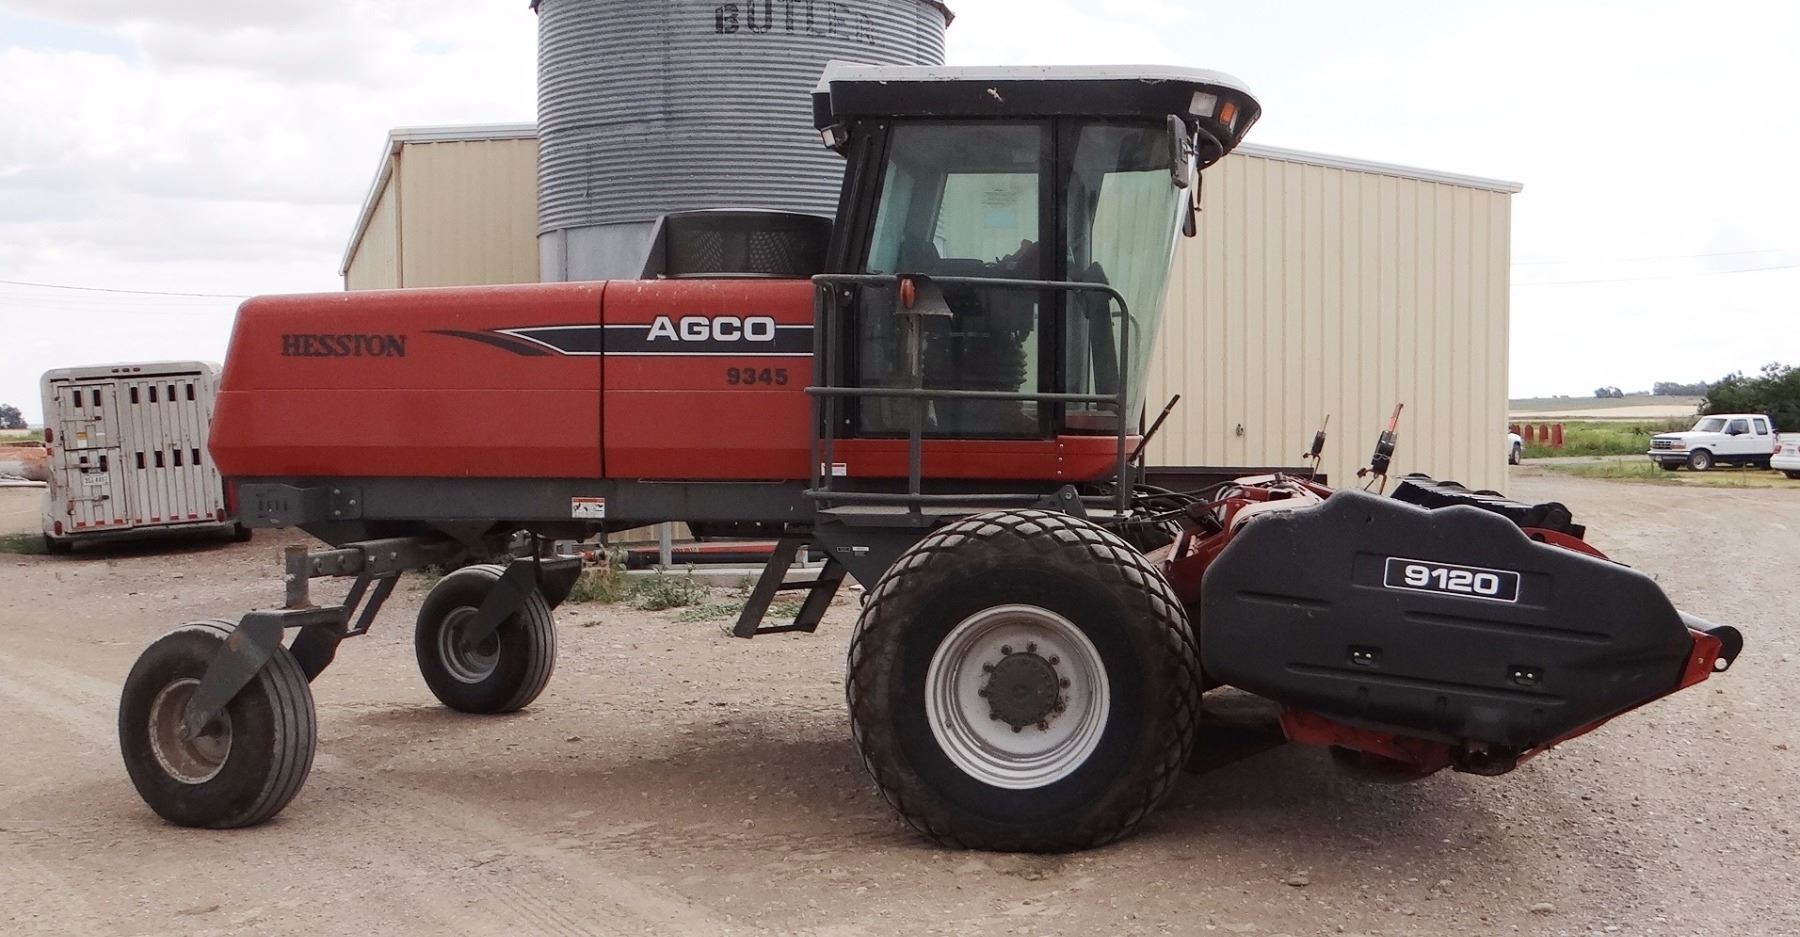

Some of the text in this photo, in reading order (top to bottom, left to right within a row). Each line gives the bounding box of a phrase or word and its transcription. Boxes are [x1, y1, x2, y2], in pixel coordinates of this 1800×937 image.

[714, 0, 876, 45] BUTLER
[646, 316, 776, 342] AGCO
[281, 334, 407, 357] HESSTON
[727, 367, 788, 385] 9345
[1404, 564, 1499, 595] 9120
